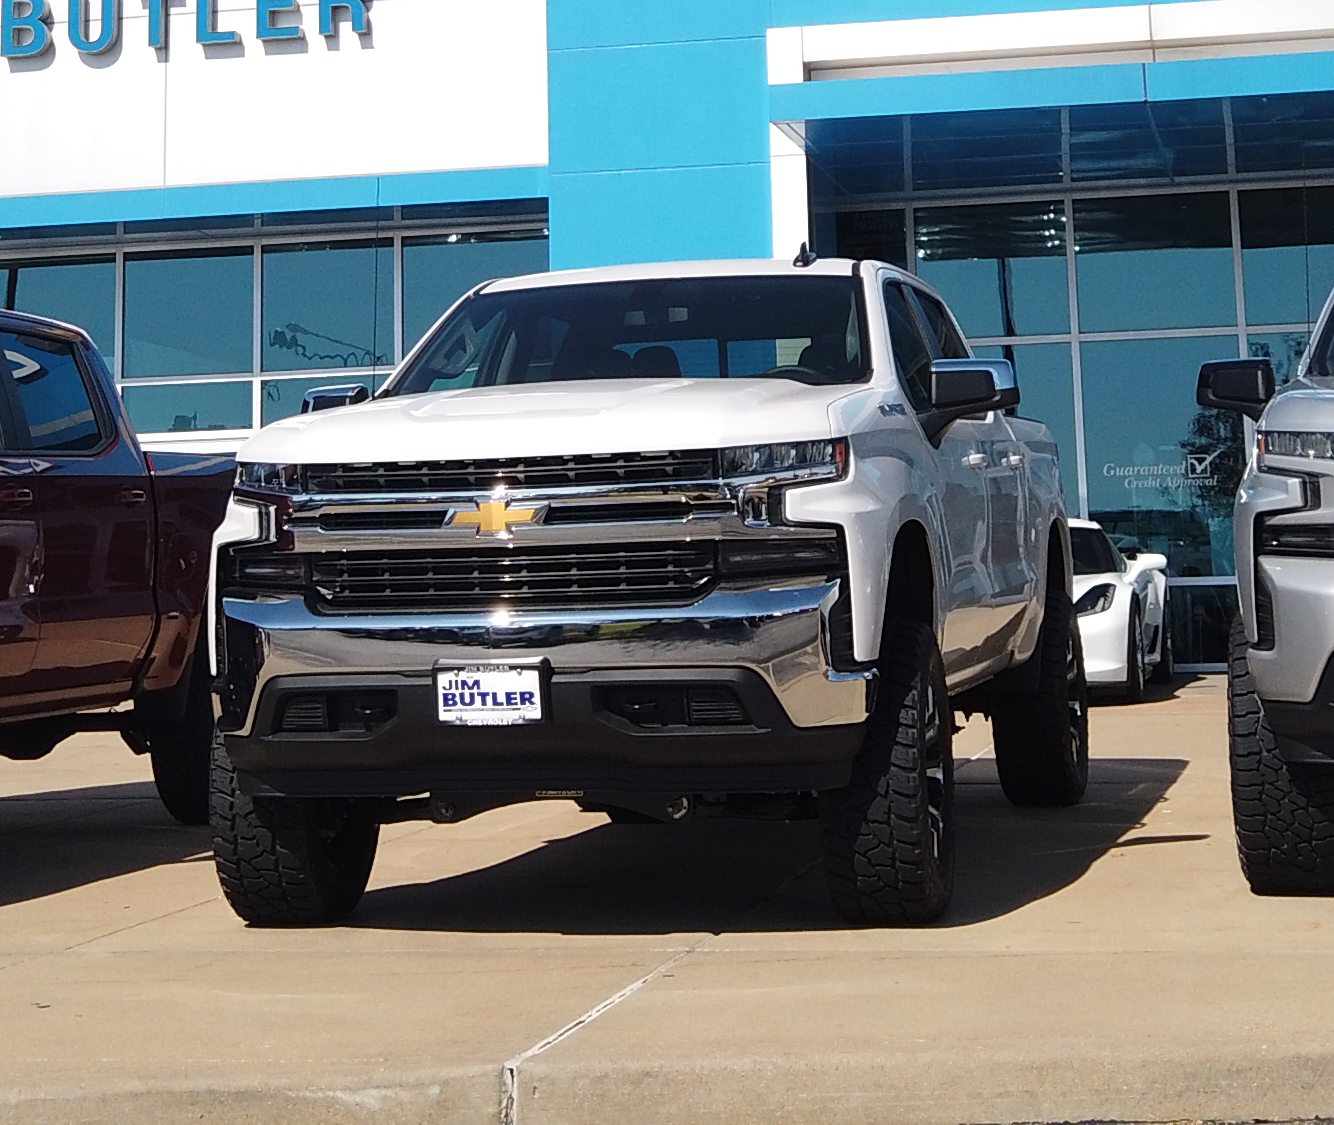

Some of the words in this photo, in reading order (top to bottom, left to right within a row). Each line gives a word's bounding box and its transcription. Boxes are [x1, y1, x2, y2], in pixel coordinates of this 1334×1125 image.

[1103, 460, 1187, 477] Guaranteed
[1124, 476, 1161, 489] Credit
[1163, 475, 1218, 491] Approval
[464, 665, 479, 673] JIM
[479, 665, 511, 674] BUTLER
[442, 679, 481, 691] JIM
[442, 690, 538, 708] BUTLER
[466, 718, 514, 726] CHEVROLET
